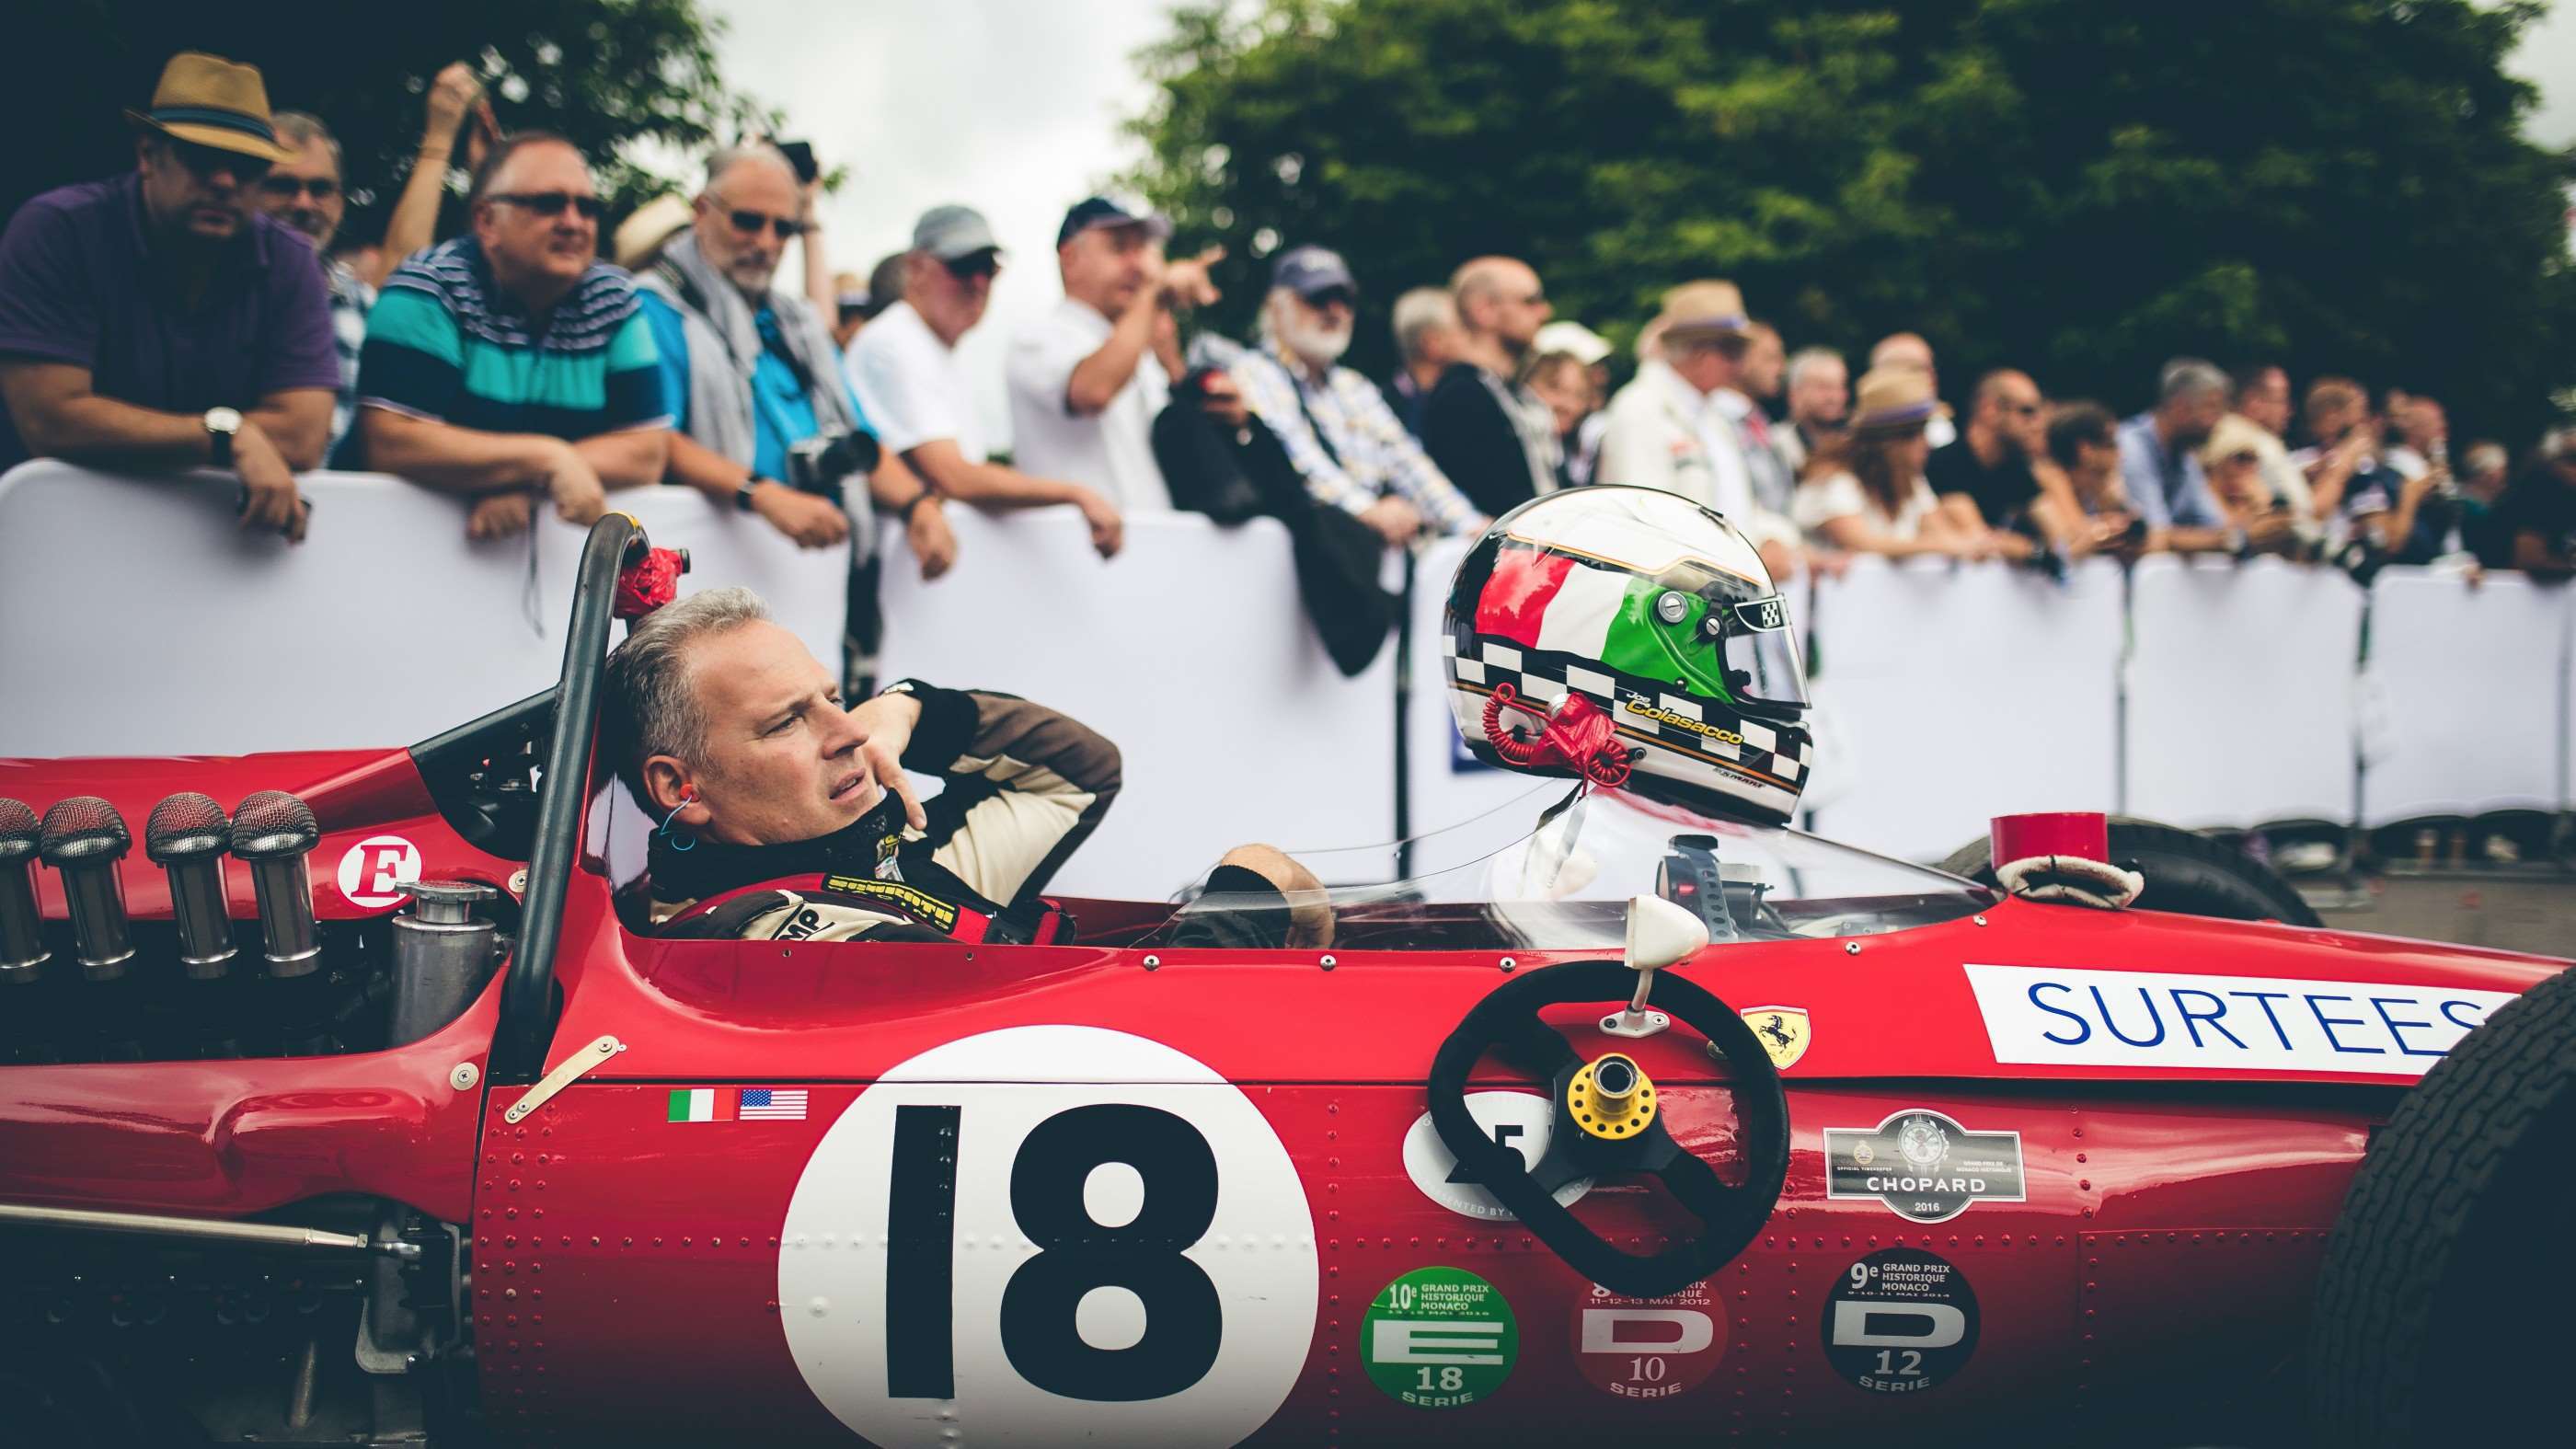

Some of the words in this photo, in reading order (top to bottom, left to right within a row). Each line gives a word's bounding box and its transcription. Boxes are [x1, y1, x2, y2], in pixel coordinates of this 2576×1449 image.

[1627, 691, 1650, 703] Joe
[1625, 699, 1744, 745] Colasacco
[351, 845, 408, 898] E
[1867, 1177, 1985, 1192] CHOPARD
[1915, 1202, 1939, 1212] 2016
[886, 1103, 1223, 1402] 18
[1883, 1263, 1921, 1272] GRAND
[1924, 1264, 1949, 1273] PRIX
[1882, 1273, 1946, 1283] HISTORIQUE
[1420, 1284, 1459, 1293] GRAND
[1463, 1284, 1489, 1293] PRIX
[1882, 1282, 1929, 1292] MONACO
[1420, 1293, 1485, 1303] HISTORIQUE
[1420, 1302, 1469, 1311] MONACO
[1581, 1308, 1713, 1353] D
[1833, 1300, 1965, 1347] D
[1373, 1319, 1504, 1364] E
[1628, 1356, 1666, 1381] 10
[1875, 1350, 1922, 1374] 12
[1416, 1366, 1464, 1390] 18
[1858, 1375, 1930, 1391] SERIE
[1610, 1382, 1682, 1397] SERIE
[1401, 1391, 1474, 1407] SERIE
